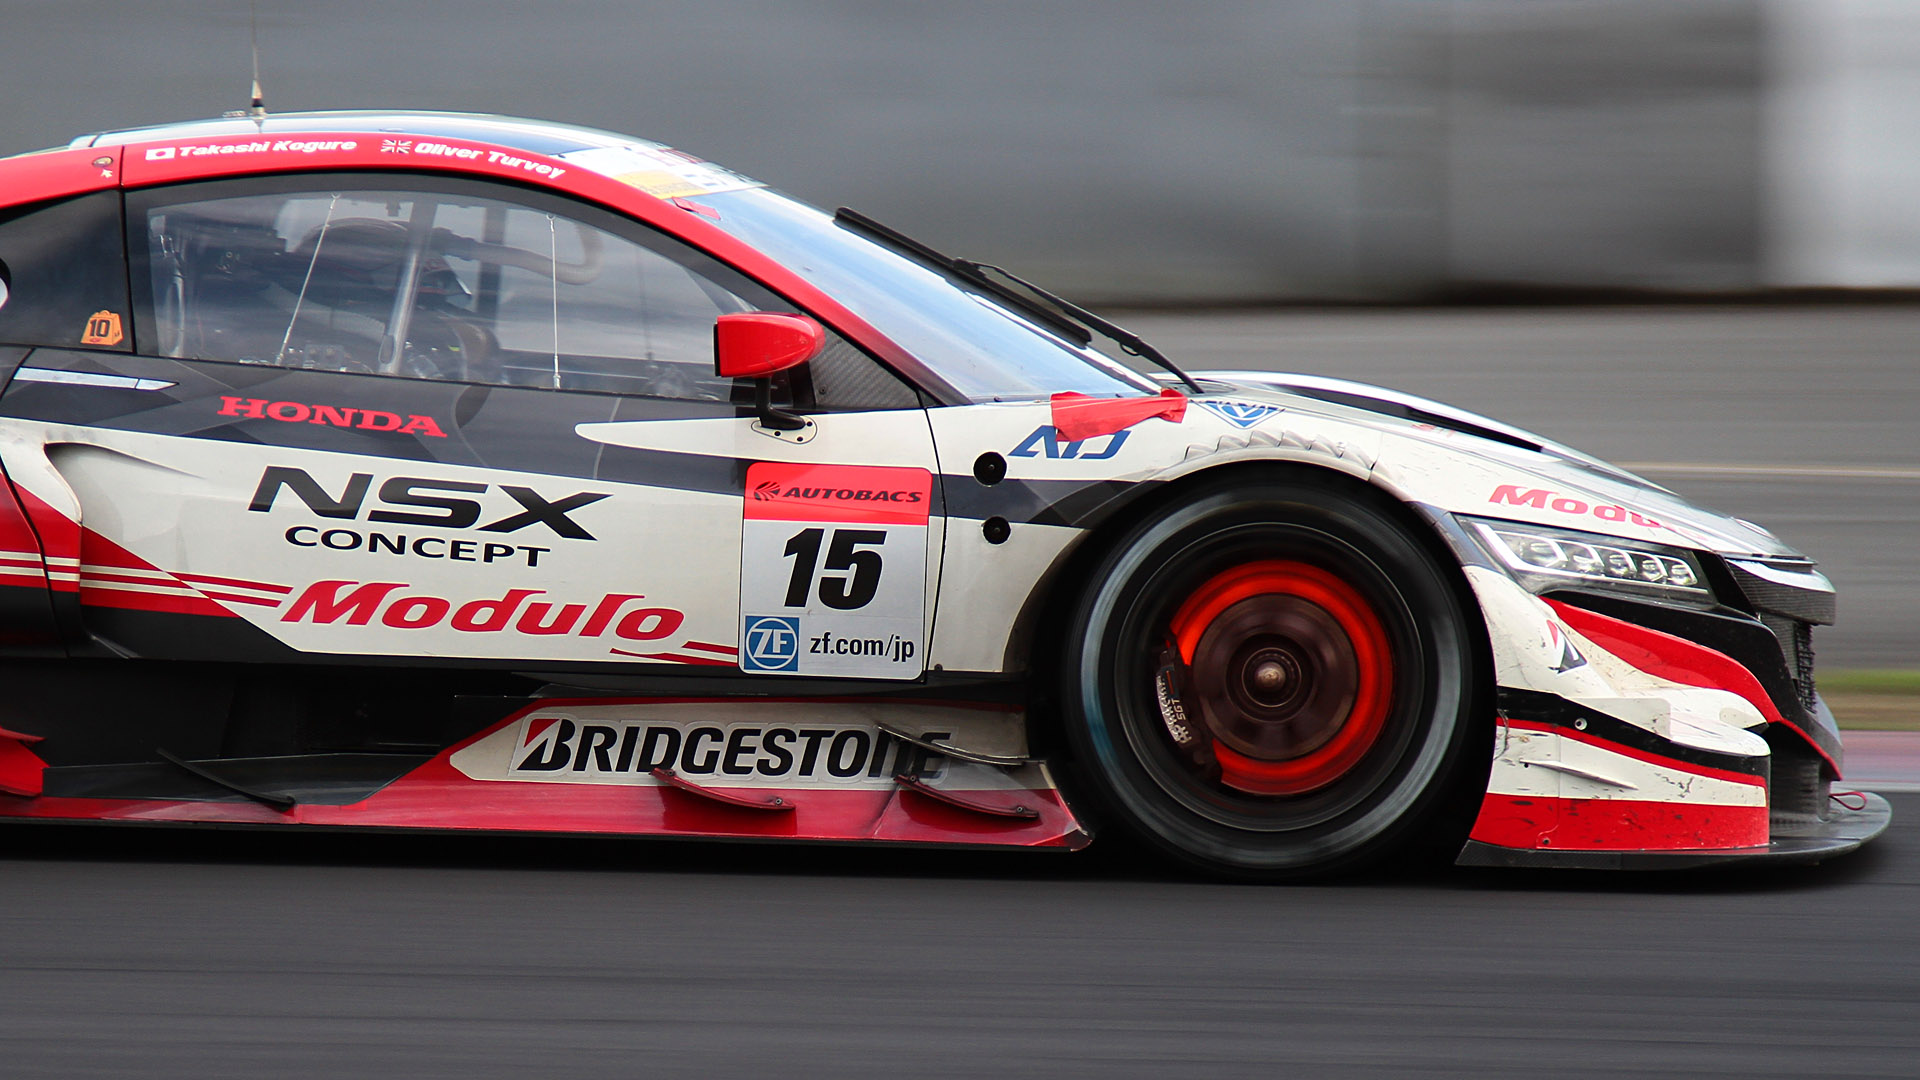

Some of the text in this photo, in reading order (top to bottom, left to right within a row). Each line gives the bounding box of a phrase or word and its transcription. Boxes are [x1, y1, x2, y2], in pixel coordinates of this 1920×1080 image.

[179, 140, 357, 157] Takashi Kogure
[414, 142, 566, 179] Oliver Turvey
[89, 319, 111, 337] 10
[217, 396, 447, 438] HONDA
[248, 465, 613, 541] NSX
[783, 486, 923, 504] AUTOBACS
[1489, 485, 1708, 541] Modu
[285, 526, 551, 567] CONCEPT
[782, 528, 887, 611] 15
[280, 580, 685, 640] Modulo
[751, 628, 792, 656] ZF
[809, 633, 915, 662] zf.com/jp
